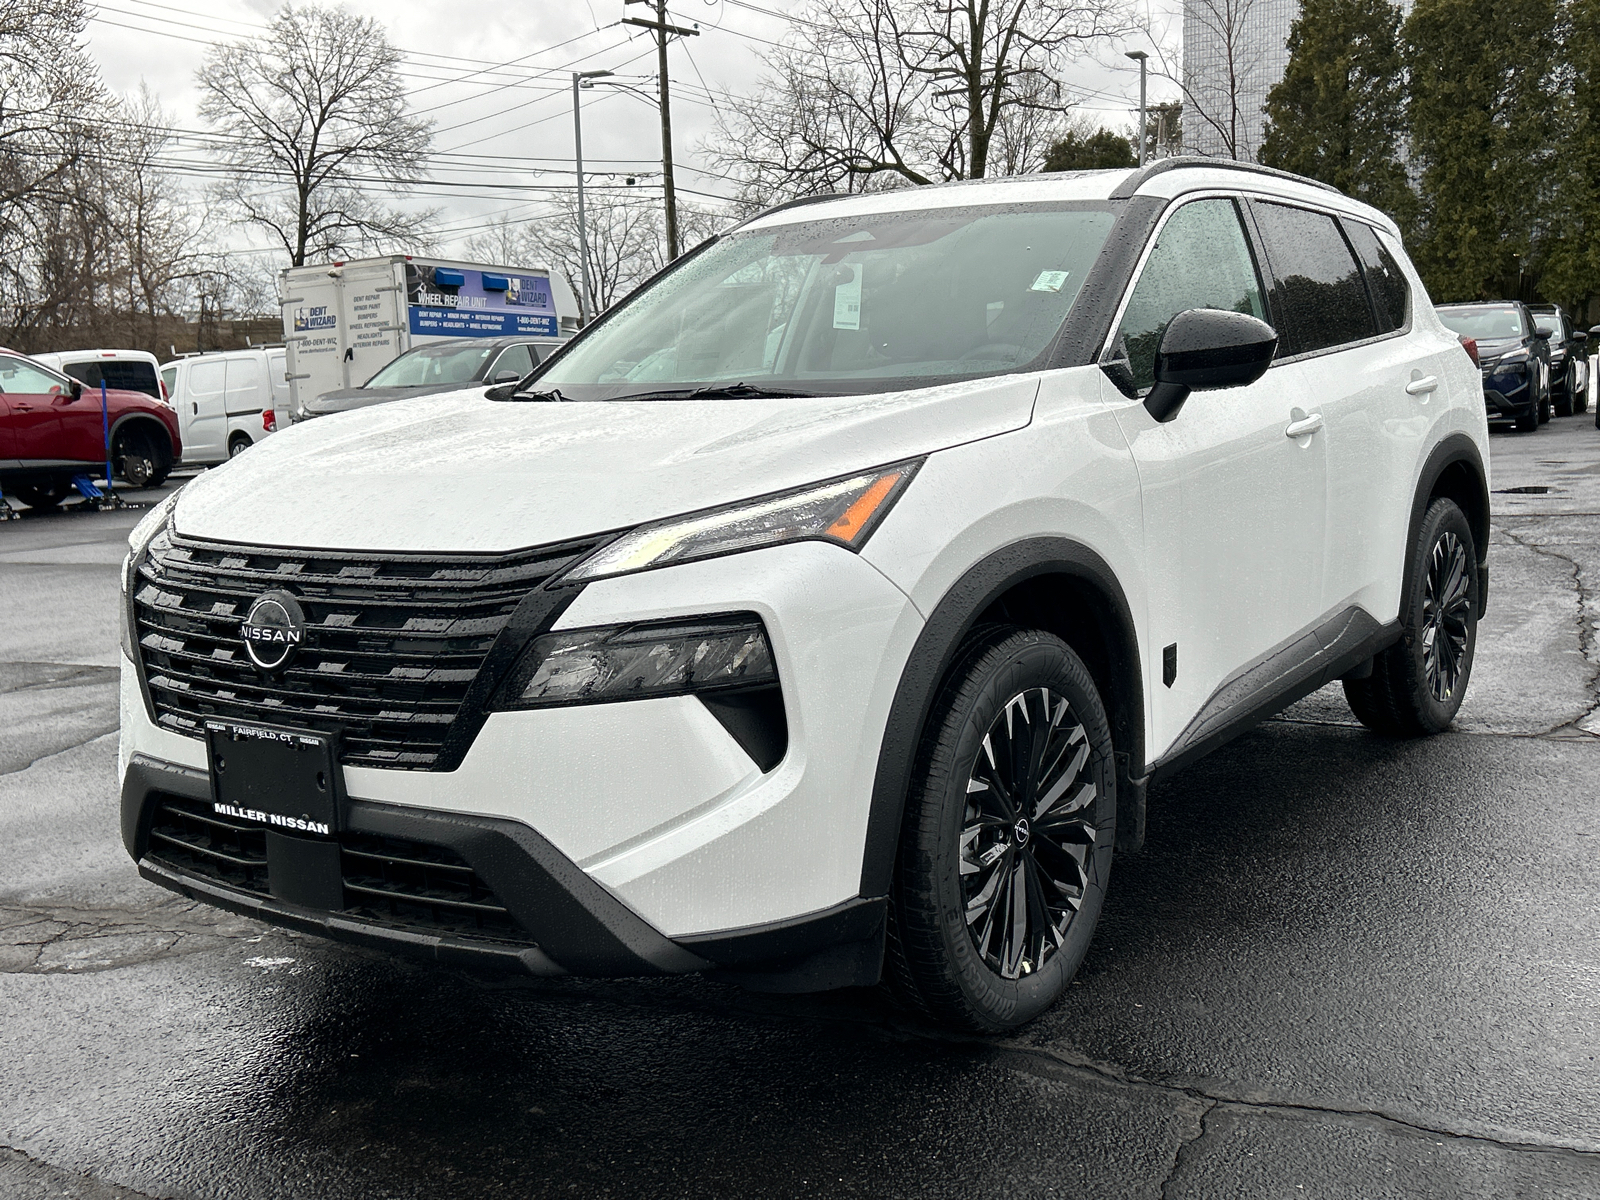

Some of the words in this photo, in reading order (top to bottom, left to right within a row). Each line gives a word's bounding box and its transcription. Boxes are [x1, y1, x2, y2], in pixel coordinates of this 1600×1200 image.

[521, 279, 539, 291] DENT
[417, 292, 443, 305] WHEEL
[444, 294, 470, 307] REPAIR
[471, 296, 488, 308] UNIT
[521, 291, 547, 304] WIZARD
[310, 305, 328, 317] DENT
[357, 312, 379, 320] BUMPERS
[418, 310, 429, 318] DENT
[310, 315, 337, 327] WIZARD
[419, 320, 438, 328] BUMPERS
[357, 331, 383, 340] HEADLIGHTS
[241, 625, 300, 642] NISSAN
[206, 723, 226, 731] NISSAN
[233, 726, 279, 741] FAIRFIELD,
[300, 737, 320, 746] NISSAN
[214, 802, 267, 823] MILLER
[269, 813, 329, 835] NISSAN
[944, 906, 1019, 1022] BRIDGESTONE
